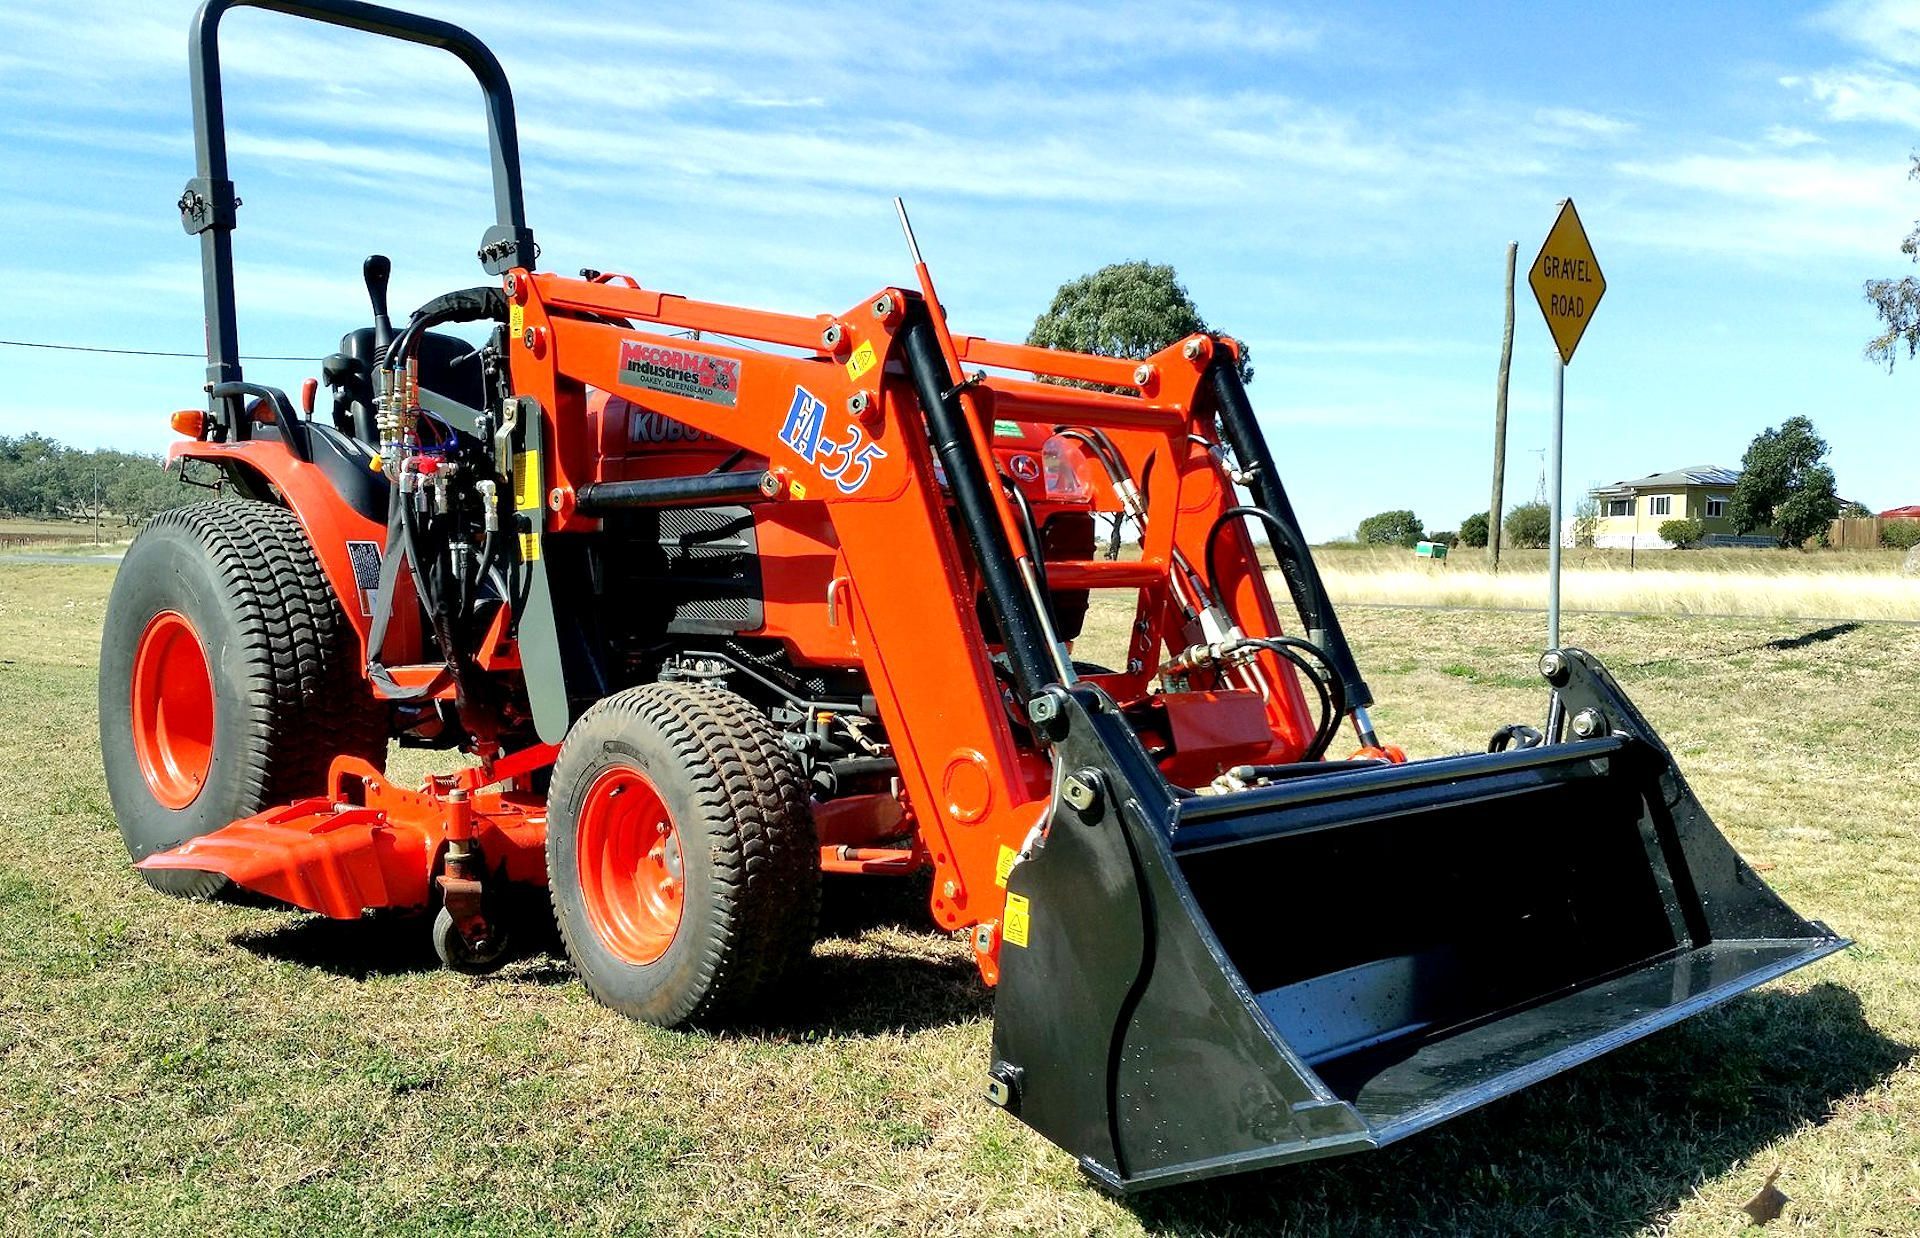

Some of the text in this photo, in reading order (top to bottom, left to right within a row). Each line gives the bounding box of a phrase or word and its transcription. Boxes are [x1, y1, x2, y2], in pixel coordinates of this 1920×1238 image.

[1543, 255, 1592, 283] GRAVEL
[1551, 293, 1584, 318] ROAD
[665, 380, 713, 396] QUEENSLAND
[632, 411, 712, 442] KUB
[778, 384, 888, 494] FA-35
